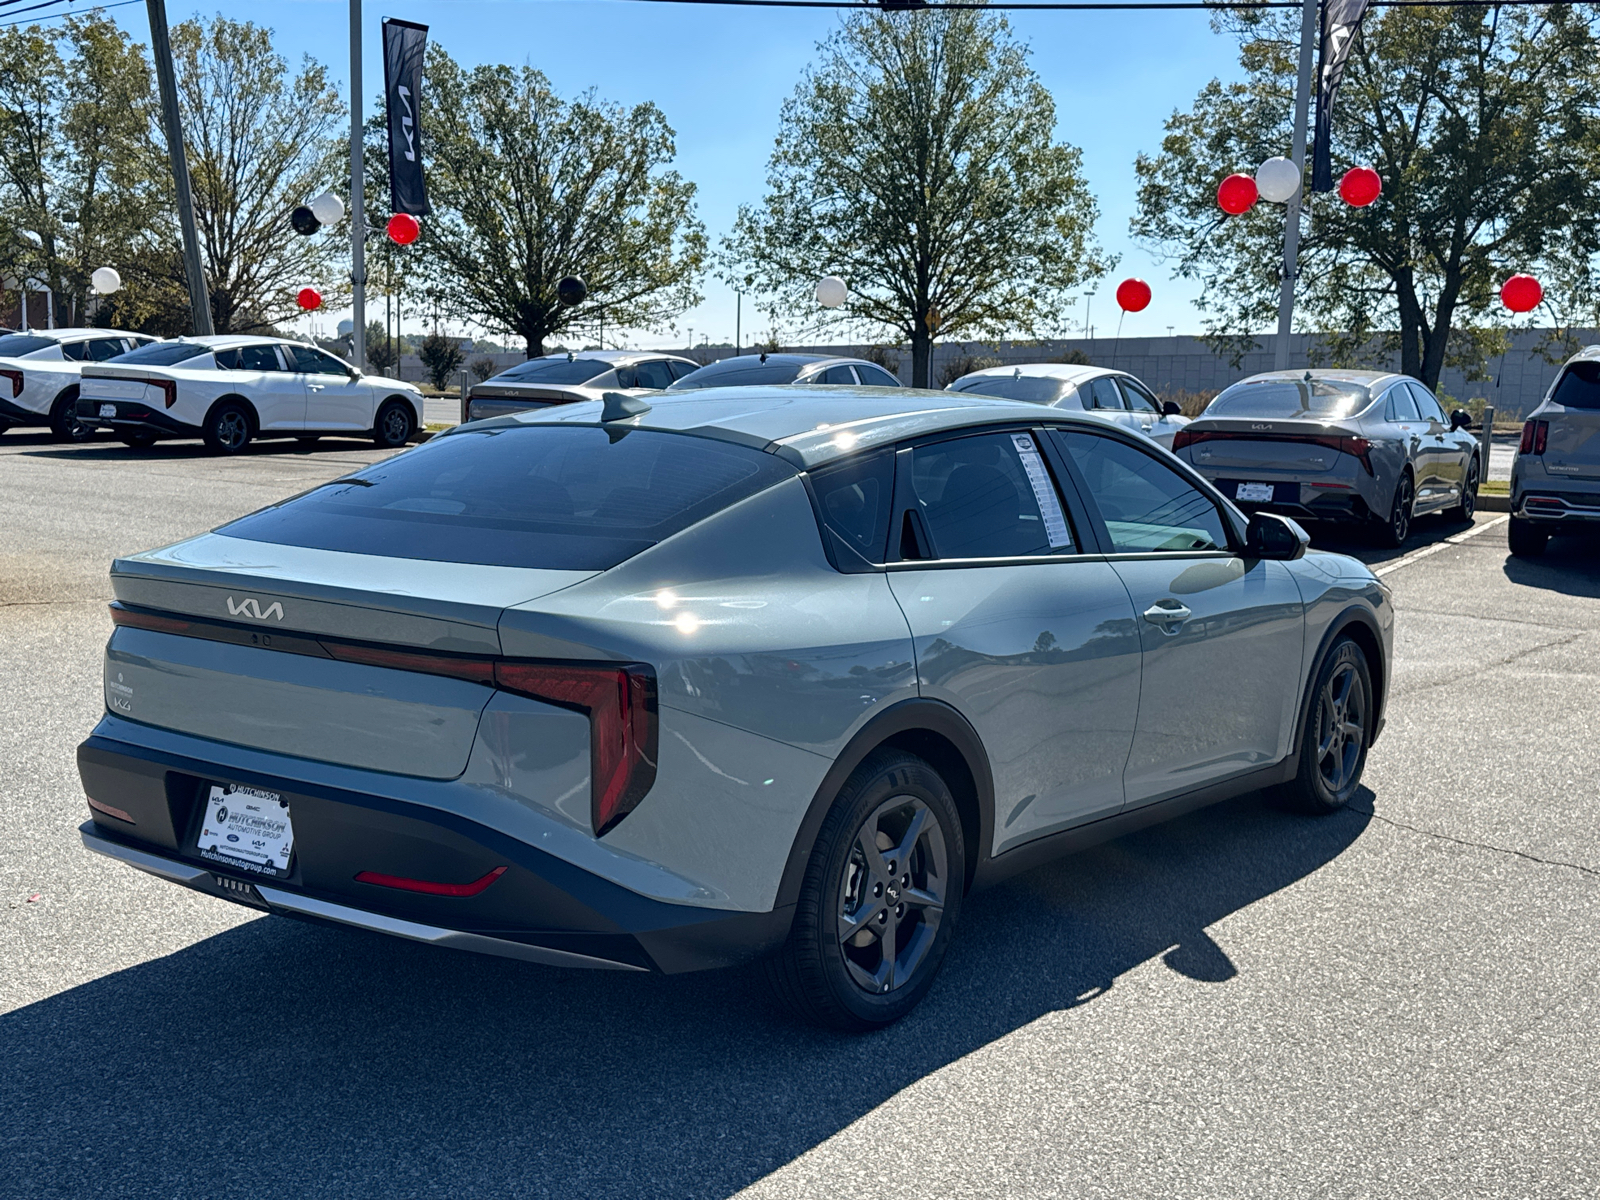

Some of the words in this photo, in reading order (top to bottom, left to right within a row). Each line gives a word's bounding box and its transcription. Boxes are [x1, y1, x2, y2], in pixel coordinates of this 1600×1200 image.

[398, 85, 415, 161] KIA
[226, 595, 284, 621] KIA
[114, 696, 131, 711] K4
[238, 785, 280, 801] HUTCHINSON
[227, 823, 261, 837] AUTOMOTIVE
[262, 830, 282, 840] GROUP
[228, 812, 287, 833] HUTCHINSON
[940, 790, 963, 856] KUMHO
[201, 849, 277, 876] Hutchinsonautogroup.com
